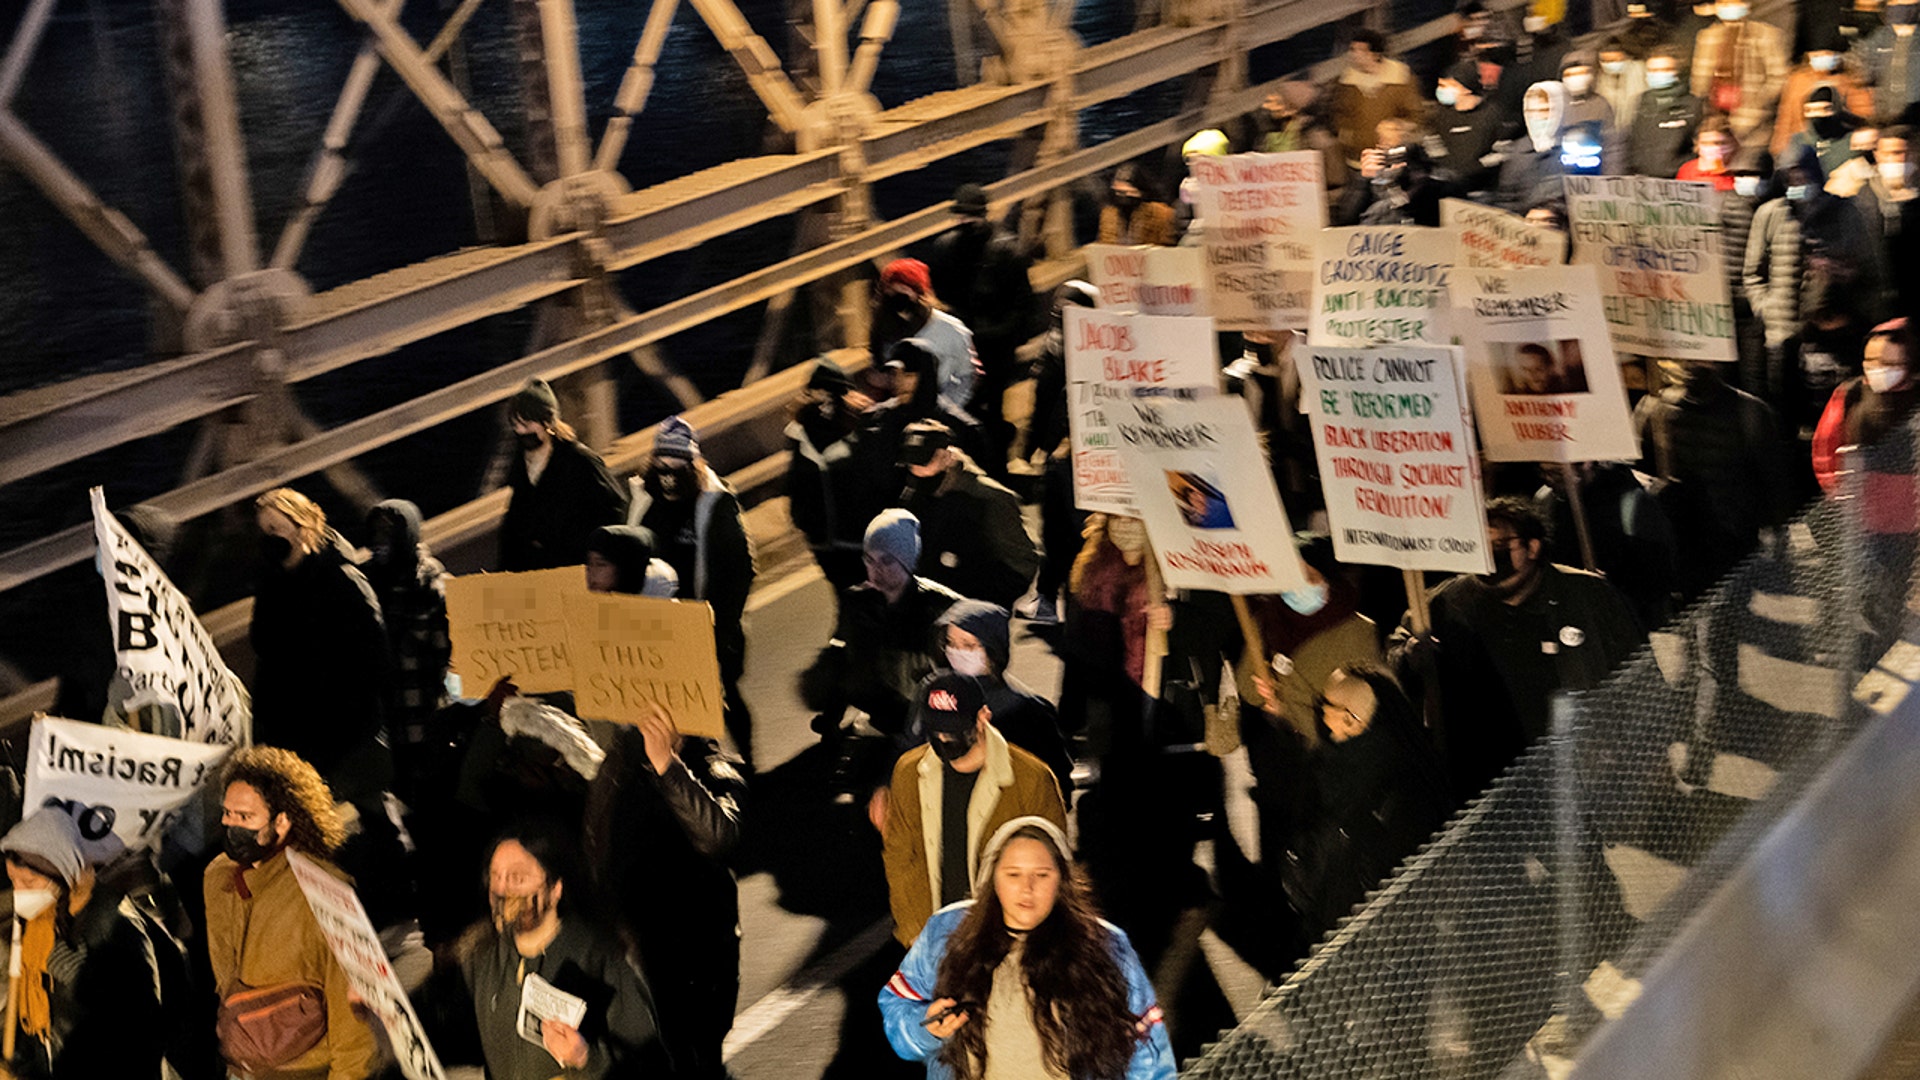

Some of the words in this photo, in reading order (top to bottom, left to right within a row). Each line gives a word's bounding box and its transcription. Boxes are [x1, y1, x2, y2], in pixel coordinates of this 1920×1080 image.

[1567, 177, 1593, 195] NO
[1606, 178, 1630, 197] TO
[1632, 181, 1704, 203] RACIST
[1577, 200, 1618, 220] GUN
[1625, 203, 1722, 226] CONTROL
[1347, 233, 1404, 256] GAIGE
[1575, 222, 1614, 243] FOR
[1651, 227, 1722, 253] RIGHT
[1104, 253, 1146, 276] ONLY
[1321, 260, 1454, 286] GROSSKREUTZ
[1475, 275, 1509, 294] WE
[1472, 292, 1572, 317] REMEMBER
[1603, 296, 1733, 338] ELF-DEFENSE
[1075, 318, 1136, 352] JACOB
[1326, 319, 1426, 341] PROTESTER
[1103, 356, 1168, 382] BLAKE
[1312, 355, 1366, 381] POLICE
[1372, 357, 1438, 384] CANNOT
[1320, 389, 1341, 415] BE
[1503, 400, 1577, 418] ANTHONY
[1323, 424, 1369, 449] BLACK
[1371, 430, 1455, 454] LIBERATION
[1511, 422, 1576, 441] HUBER
[1331, 456, 1394, 485] THROUGH
[1400, 463, 1466, 489] SOCIALIST
[1355, 487, 1454, 519] REVOLUTION!
[1342, 528, 1437, 552] INTERNATIONALIST
[1438, 536, 1477, 554] GROUP
[475, 619, 537, 641] THIS
[470, 642, 572, 681] SYSTEM
[598, 645, 664, 670] THIS
[589, 672, 708, 712] SYSTEM
